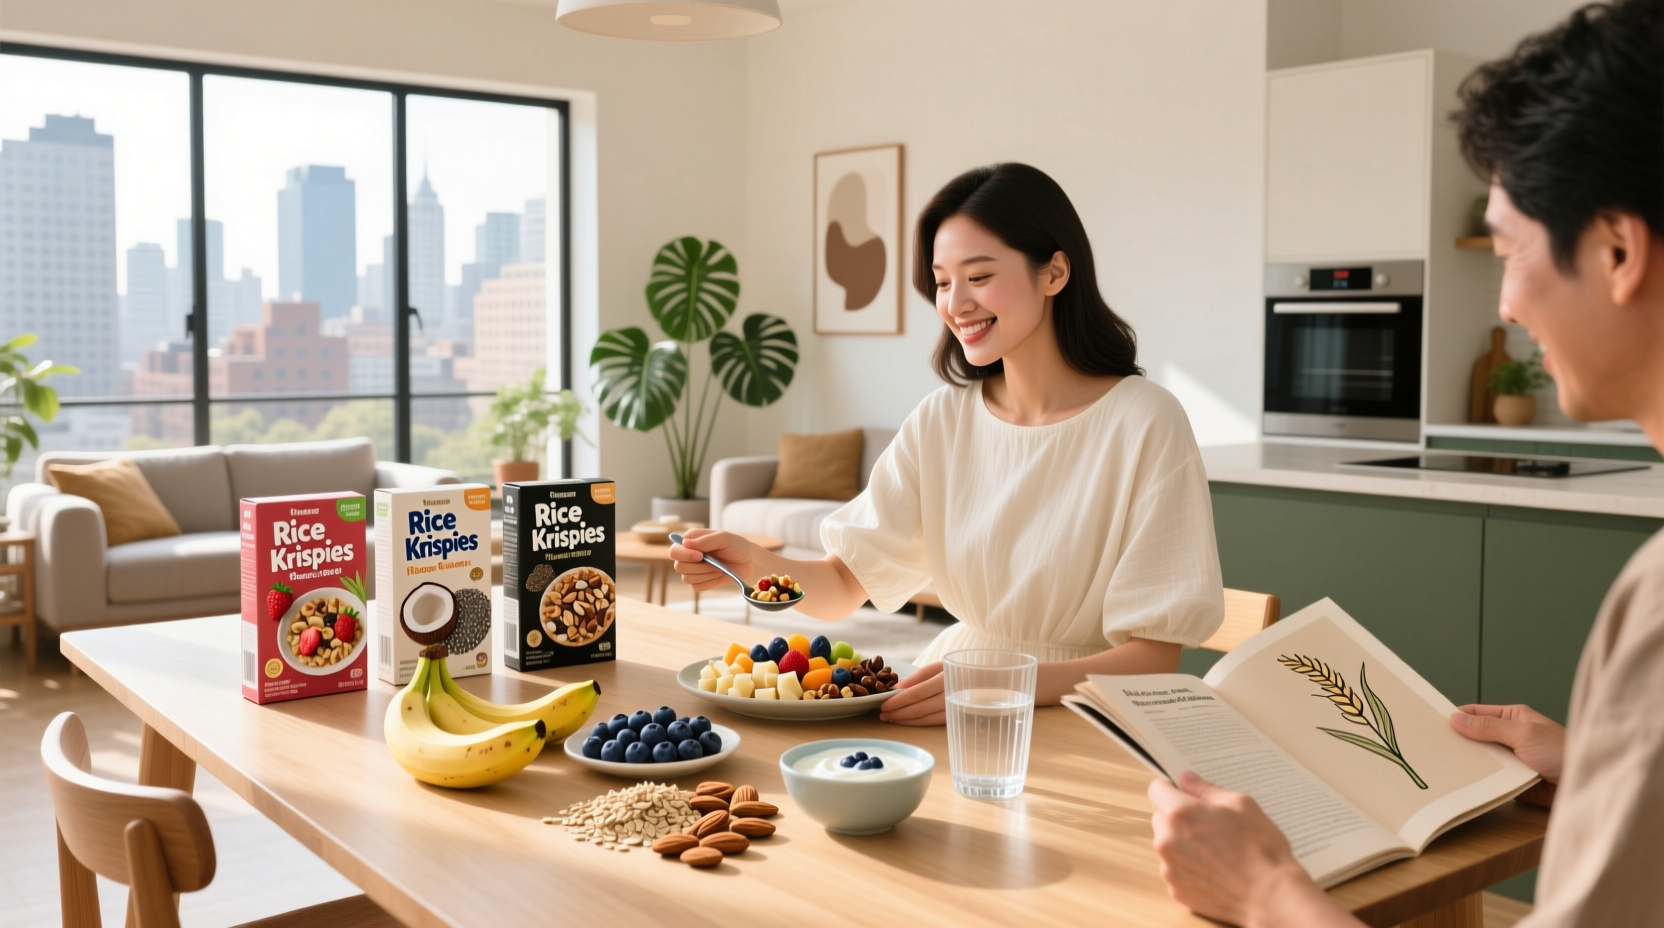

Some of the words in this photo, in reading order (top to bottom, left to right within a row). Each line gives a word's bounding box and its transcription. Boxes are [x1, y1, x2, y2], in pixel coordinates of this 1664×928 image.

[408, 509, 457, 535] Rice
[535, 501, 582, 527] Rice
[273, 519, 326, 547] Rice
[405, 530, 478, 561] Krispies
[532, 521, 605, 552] Krispies
[270, 539, 354, 573] Krispies
